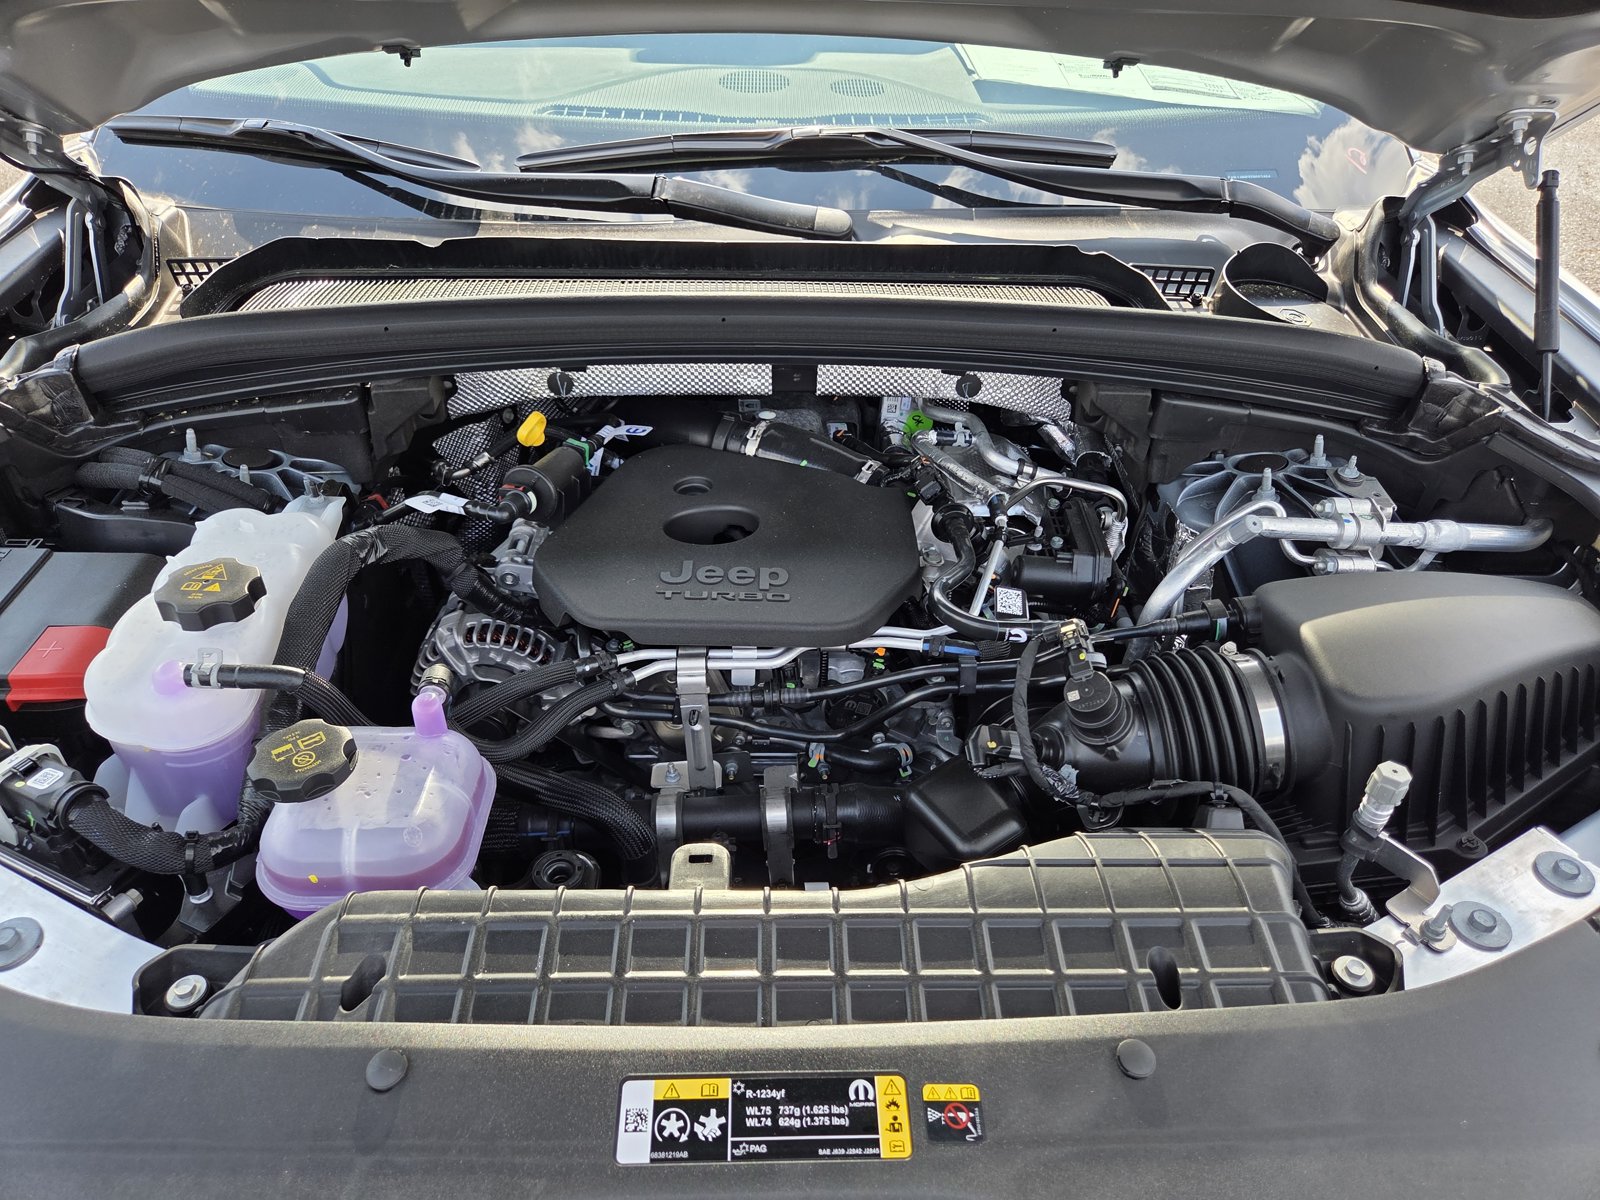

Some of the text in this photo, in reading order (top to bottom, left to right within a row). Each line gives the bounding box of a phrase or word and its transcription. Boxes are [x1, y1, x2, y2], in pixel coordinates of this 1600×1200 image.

[659, 560, 789, 591] Jeep
[656, 590, 791, 602] TURBO
[745, 1088, 786, 1100] R-1234yf
[746, 1104, 849, 1117] WL75 737g (1.625 lbs)
[746, 1115, 849, 1128] WL74 624g (1.375 lbs)
[750, 1144, 768, 1153] PAG
